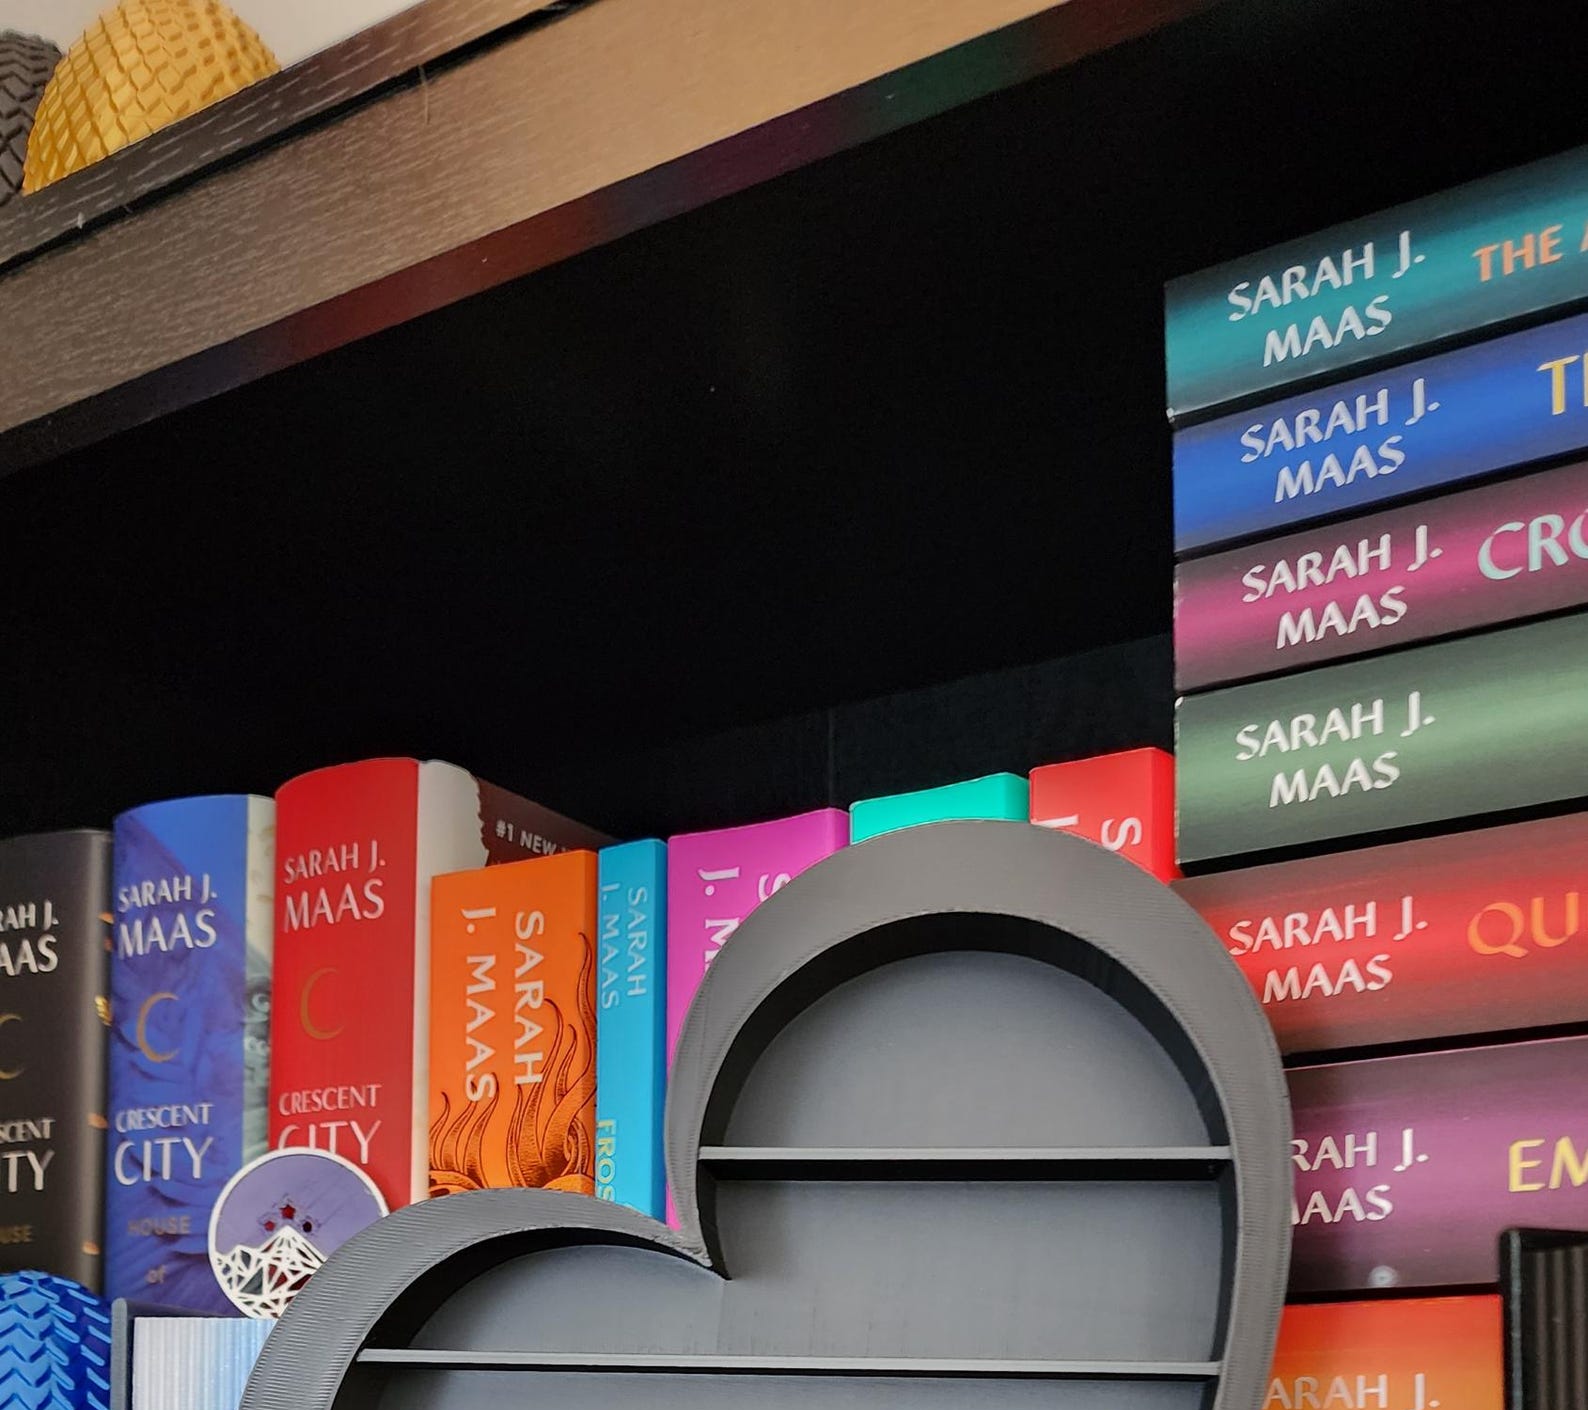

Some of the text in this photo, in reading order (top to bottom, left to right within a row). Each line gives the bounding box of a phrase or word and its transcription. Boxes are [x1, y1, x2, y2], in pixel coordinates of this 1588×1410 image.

[1227, 229, 1425, 322] SARAH J.
[1472, 224, 1564, 282] THE
[1263, 293, 1393, 367] MAAS
[1240, 378, 1441, 464] SARAH J.
[1273, 434, 1406, 503] MAAS
[1241, 524, 1442, 603] SARAH J.
[1275, 585, 1408, 649] MAAS
[1235, 691, 1436, 762] SARAH J.
[1268, 751, 1401, 809] MAAS
[496, 820, 514, 842] #1
[284, 839, 386, 885] SARAH J.
[698, 866, 740, 896] J.
[44, 899, 59, 930] J.
[118, 873, 218, 914] SARAH J.
[285, 878, 385, 934] MAAS
[118, 910, 217, 961] MAAS
[627, 886, 648, 997] SARAH
[1228, 895, 1429, 956] SARAH J.
[1466, 891, 1580, 958] QU
[600, 913, 620, 1010] MAAS
[1262, 953, 1394, 1004] MAAS
[461, 907, 497, 1103] J. MAAS
[514, 909, 545, 1085] SARAH
[115, 1102, 214, 1133] CRESCENT
[279, 1084, 382, 1117] CRESCENT
[114, 1136, 214, 1186] CITY
[1393, 1128, 1429, 1172] J.
[127, 1216, 191, 1237] HOUSE
